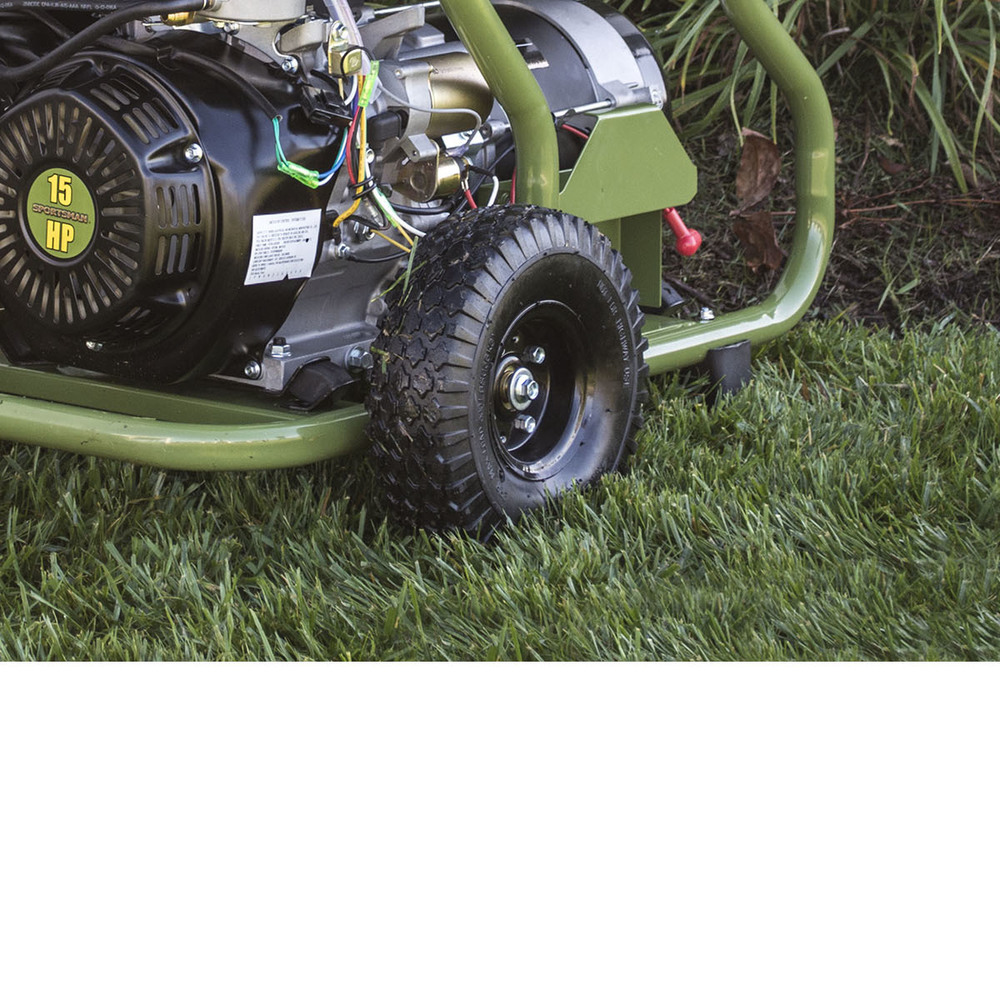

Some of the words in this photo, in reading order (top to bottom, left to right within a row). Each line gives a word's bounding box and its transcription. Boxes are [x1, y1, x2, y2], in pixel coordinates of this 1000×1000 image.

[47, 173, 73, 207] 15
[32, 203, 89, 224] SPORTSMAN
[46, 219, 75, 253] HP
